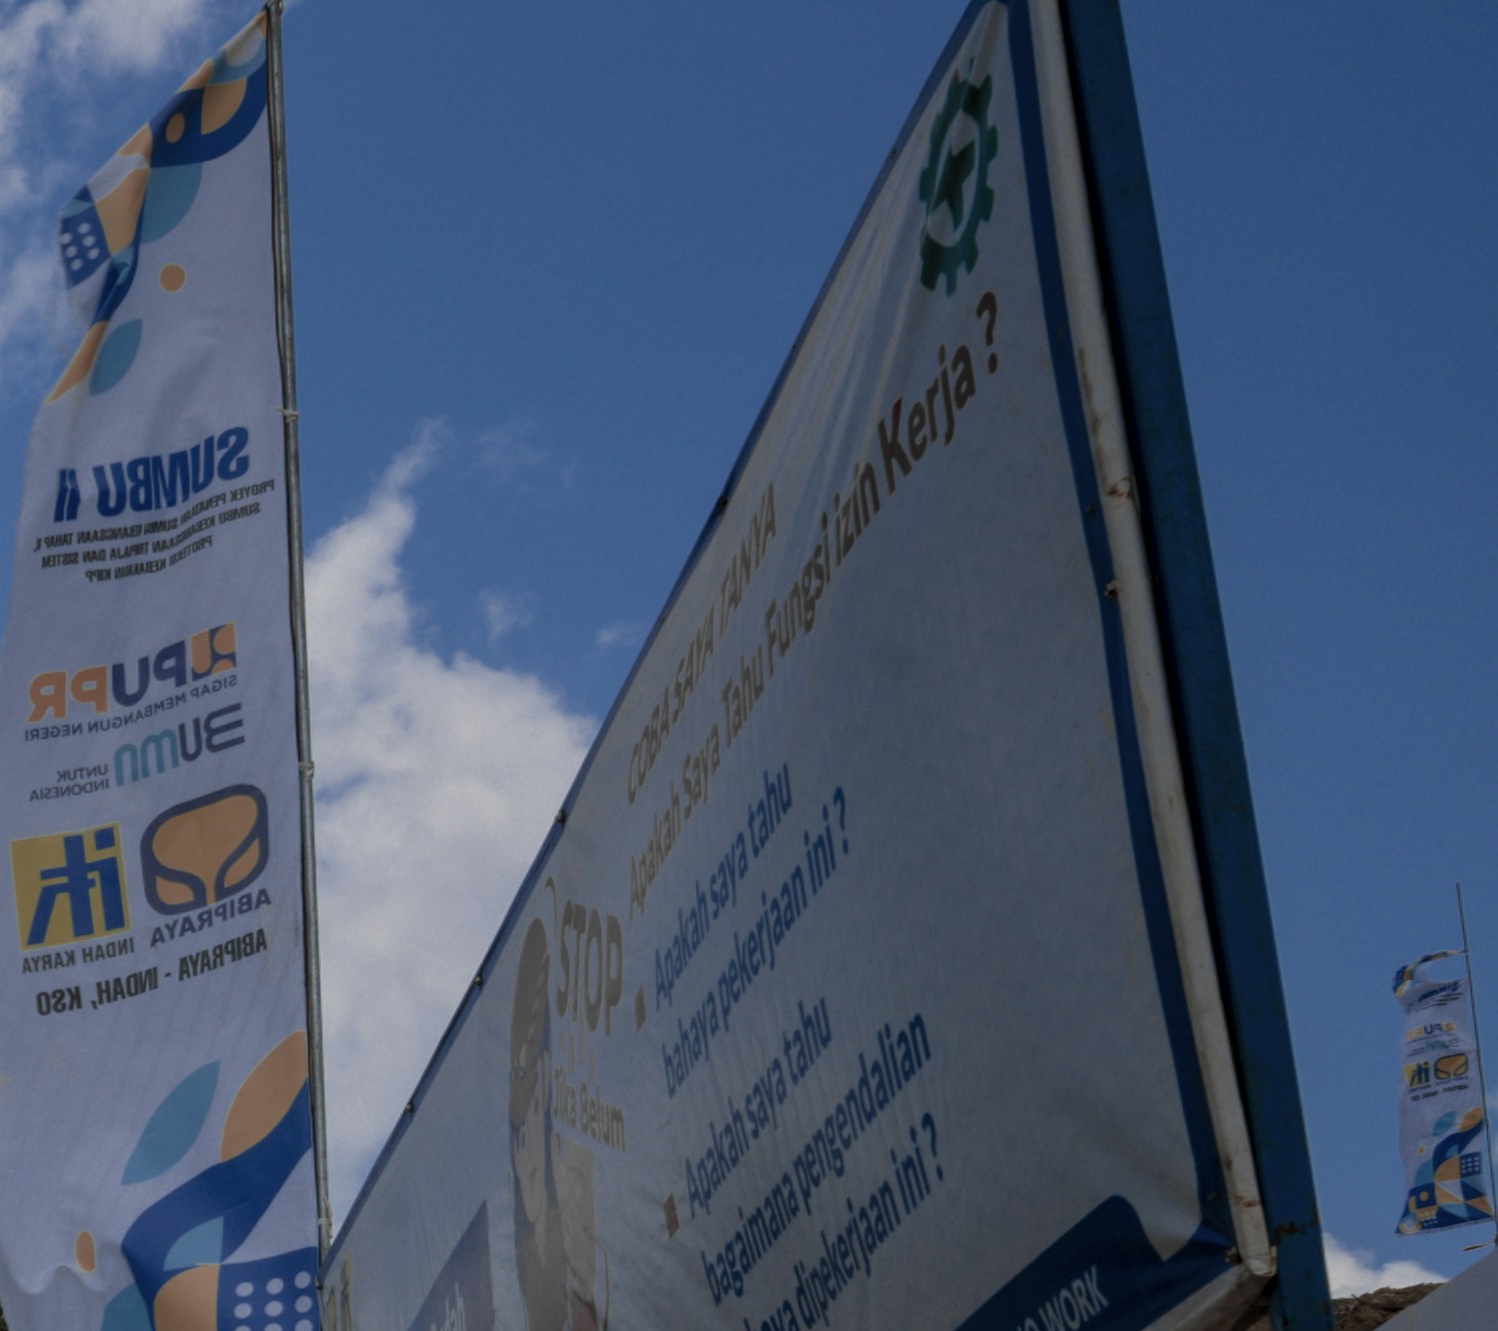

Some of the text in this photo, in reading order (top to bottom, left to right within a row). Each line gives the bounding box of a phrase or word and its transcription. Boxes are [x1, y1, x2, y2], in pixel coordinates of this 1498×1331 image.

[628, 789, 680, 920] Apakah
[683, 716, 721, 822] Saya
[722, 644, 764, 750] Tahu
[766, 511, 831, 680] Fungsi
[878, 342, 976, 494] Kerja
[556, 899, 624, 1036] STOP
[654, 762, 792, 1012] Apakah saya tahu
[662, 991, 716, 1100] bahaya
[717, 865, 808, 1039] pekerjaan
[804, 812, 834, 901] ini
[683, 997, 832, 1220] Apakah saya tahu
[701, 1013, 932, 1306] bagaimana pengendalian
[794, 1178, 898, 1329] dipekerjaan
[892, 1131, 925, 1215] ini
